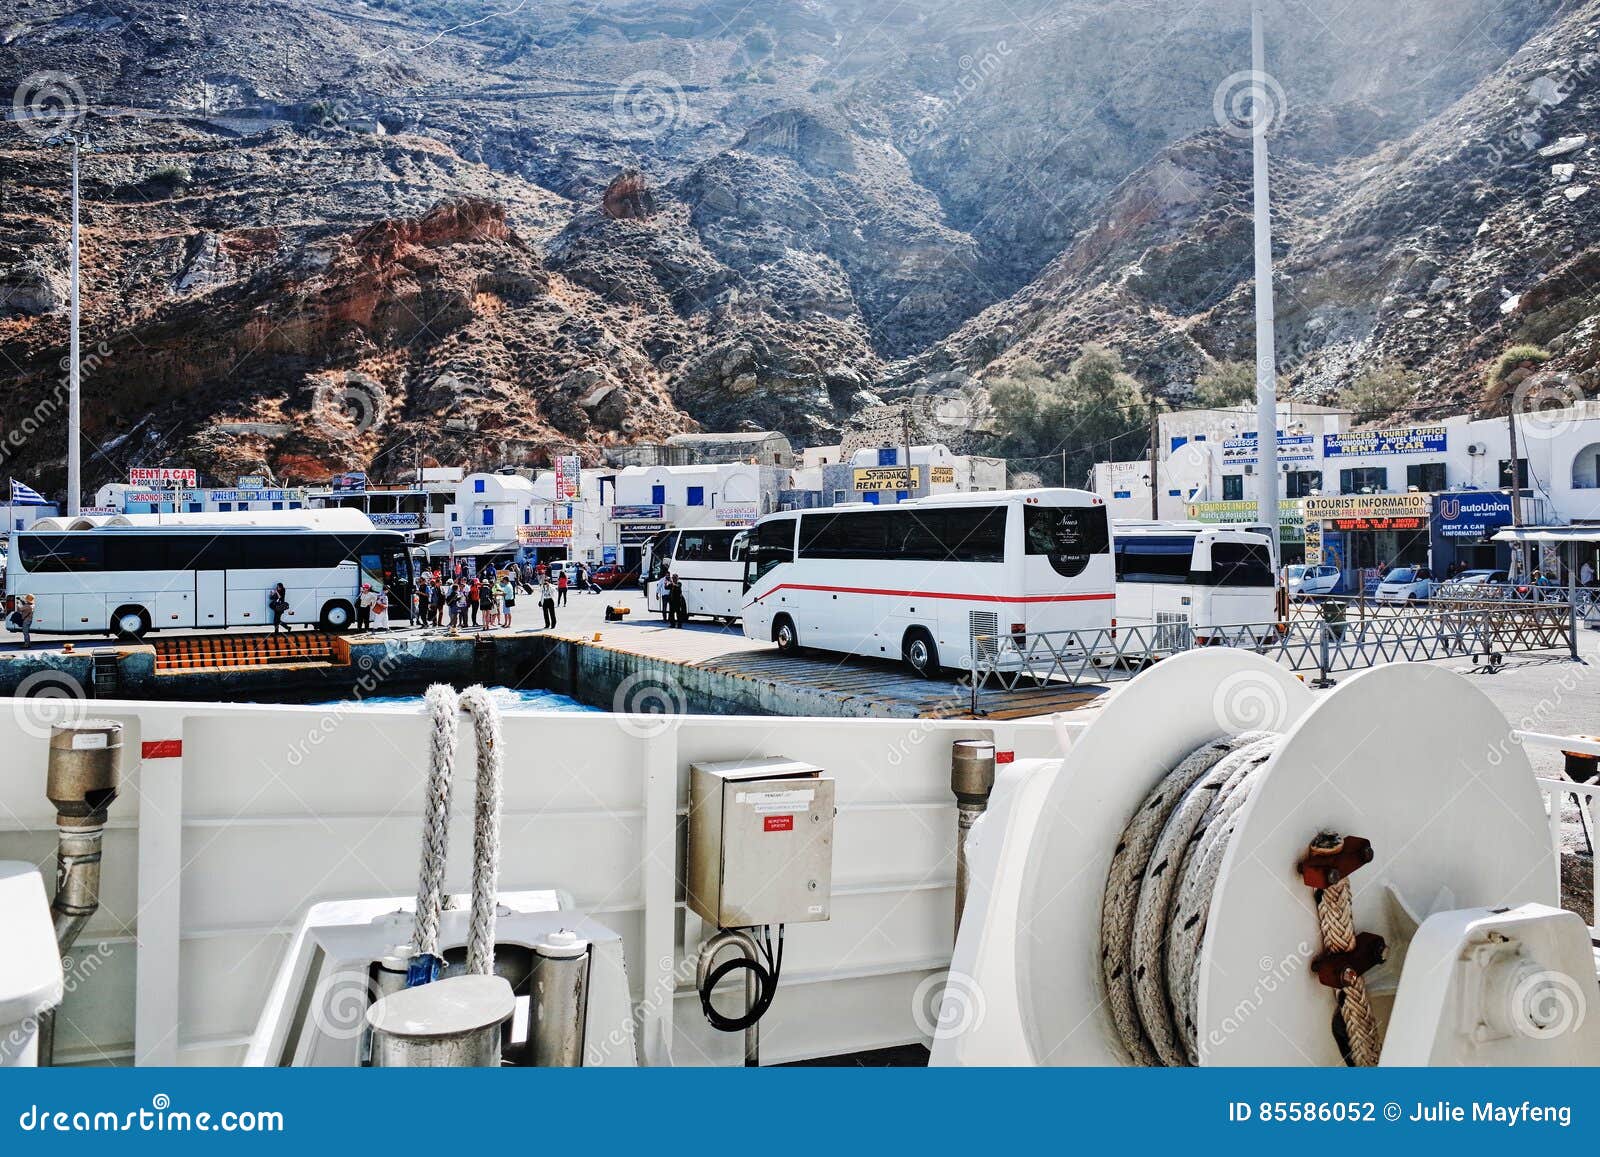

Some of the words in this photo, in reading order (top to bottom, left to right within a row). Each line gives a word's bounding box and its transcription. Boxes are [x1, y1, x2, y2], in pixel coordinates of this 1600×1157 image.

[1336, 432, 1376, 441] PRINCESS
[1380, 430, 1413, 438] TOURIST
[1416, 428, 1446, 436] OFFICE
[1327, 438, 1379, 448] ACCOMMODATION
[1386, 436, 1408, 444] HOTEL
[1409, 434, 1444, 443] SHUTTLES
[1341, 445, 1377, 453] RENT
[1381, 443, 1391, 451] A
[1394, 442, 1425, 450] CAR
[131, 469, 159, 479] RENT
[163, 469, 169, 479] A
[173, 469, 195, 479] CAR
[855, 481, 884, 490] RENT
[885, 481, 893, 489] A
[895, 480, 918, 488] CAR
[1200, 501, 1231, 511] TOURIST
[1316, 498, 1355, 509] TOURIST
[1460, 502, 1510, 512] autoUnion
[1307, 509, 1339, 518] TRANSFERS
